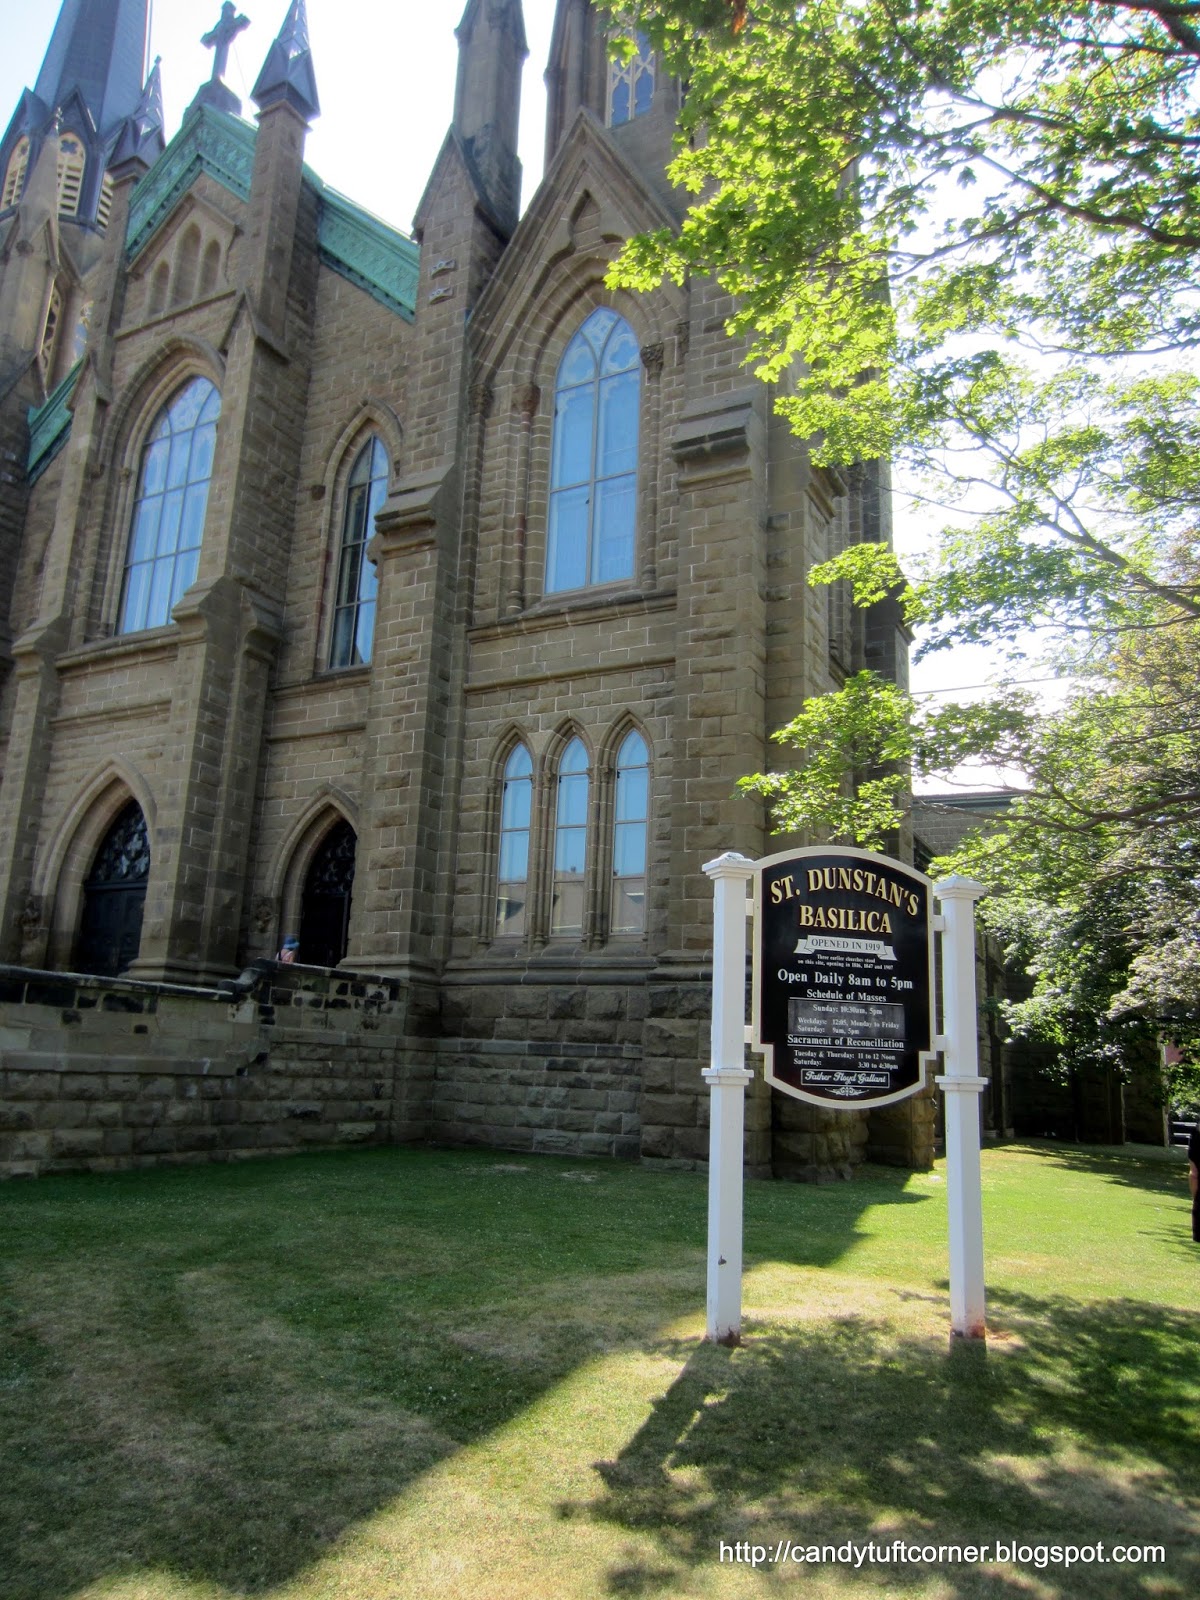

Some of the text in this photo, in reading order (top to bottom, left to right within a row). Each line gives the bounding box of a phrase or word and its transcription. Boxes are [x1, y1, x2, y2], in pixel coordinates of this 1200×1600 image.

[770, 867, 919, 916] ST. DUNSTAN'S
[800, 905, 893, 933] BASILICA
[811, 938, 881, 951] OPENED IN 1919
[777, 968, 913, 990] Open Daily 8am to 5pm
[806, 988, 887, 1002] Schedule of Masses
[813, 1004, 838, 1013] Sunday:
[869, 1007, 882, 1016] 5pm
[797, 1025, 825, 1033] Saturday:
[798, 1016, 827, 1025] Weekdays:
[850, 1020, 872, 1028] Monday
[882, 1021, 900, 1029] Friday
[787, 1034, 904, 1049] Sacrament of Reconciliation
[794, 1050, 817, 1058] Tuesday
[827, 1051, 855, 1059] Thursday:
[804, 1071, 886, 1084] Father Floyd Gallant
